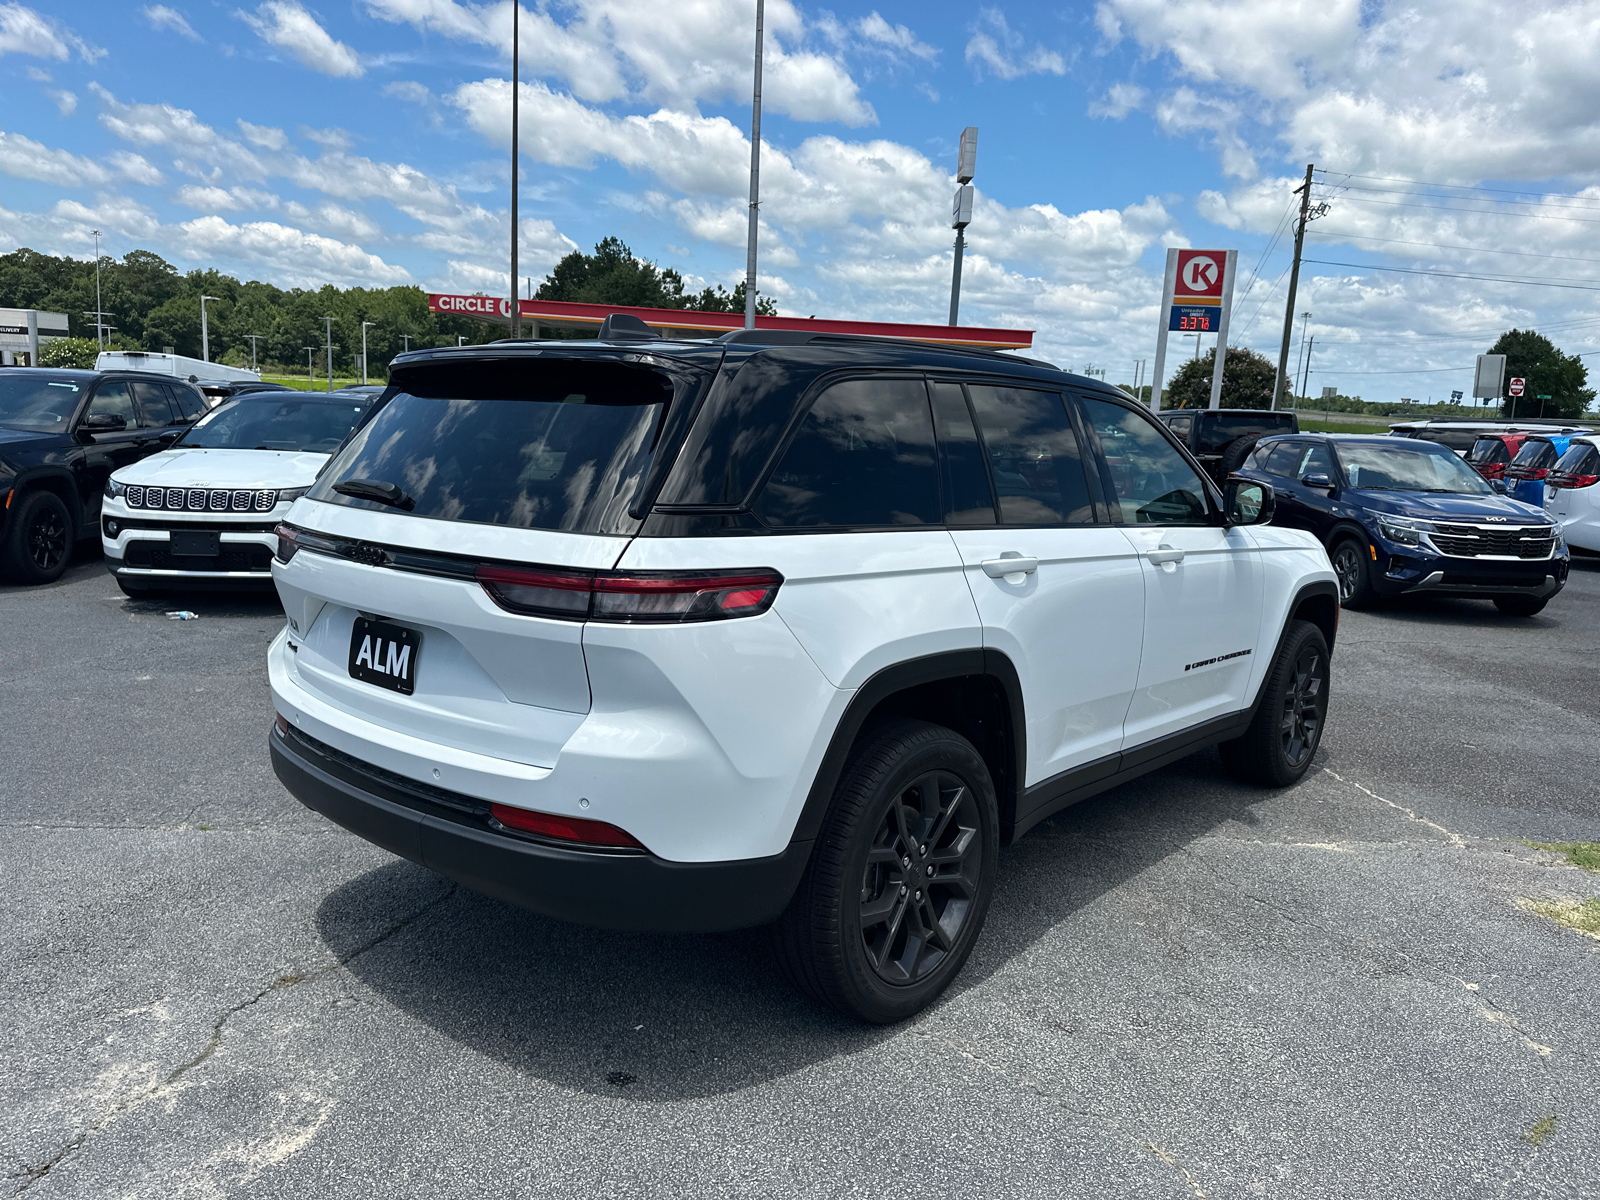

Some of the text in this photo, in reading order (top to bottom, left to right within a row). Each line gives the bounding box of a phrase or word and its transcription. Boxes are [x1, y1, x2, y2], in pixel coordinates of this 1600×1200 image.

[1191, 262, 1214, 288] K
[439, 296, 517, 314] CIRCLE K
[355, 634, 411, 680] ALM
[1192, 648, 1253, 669] GRAND CHEROKEE
